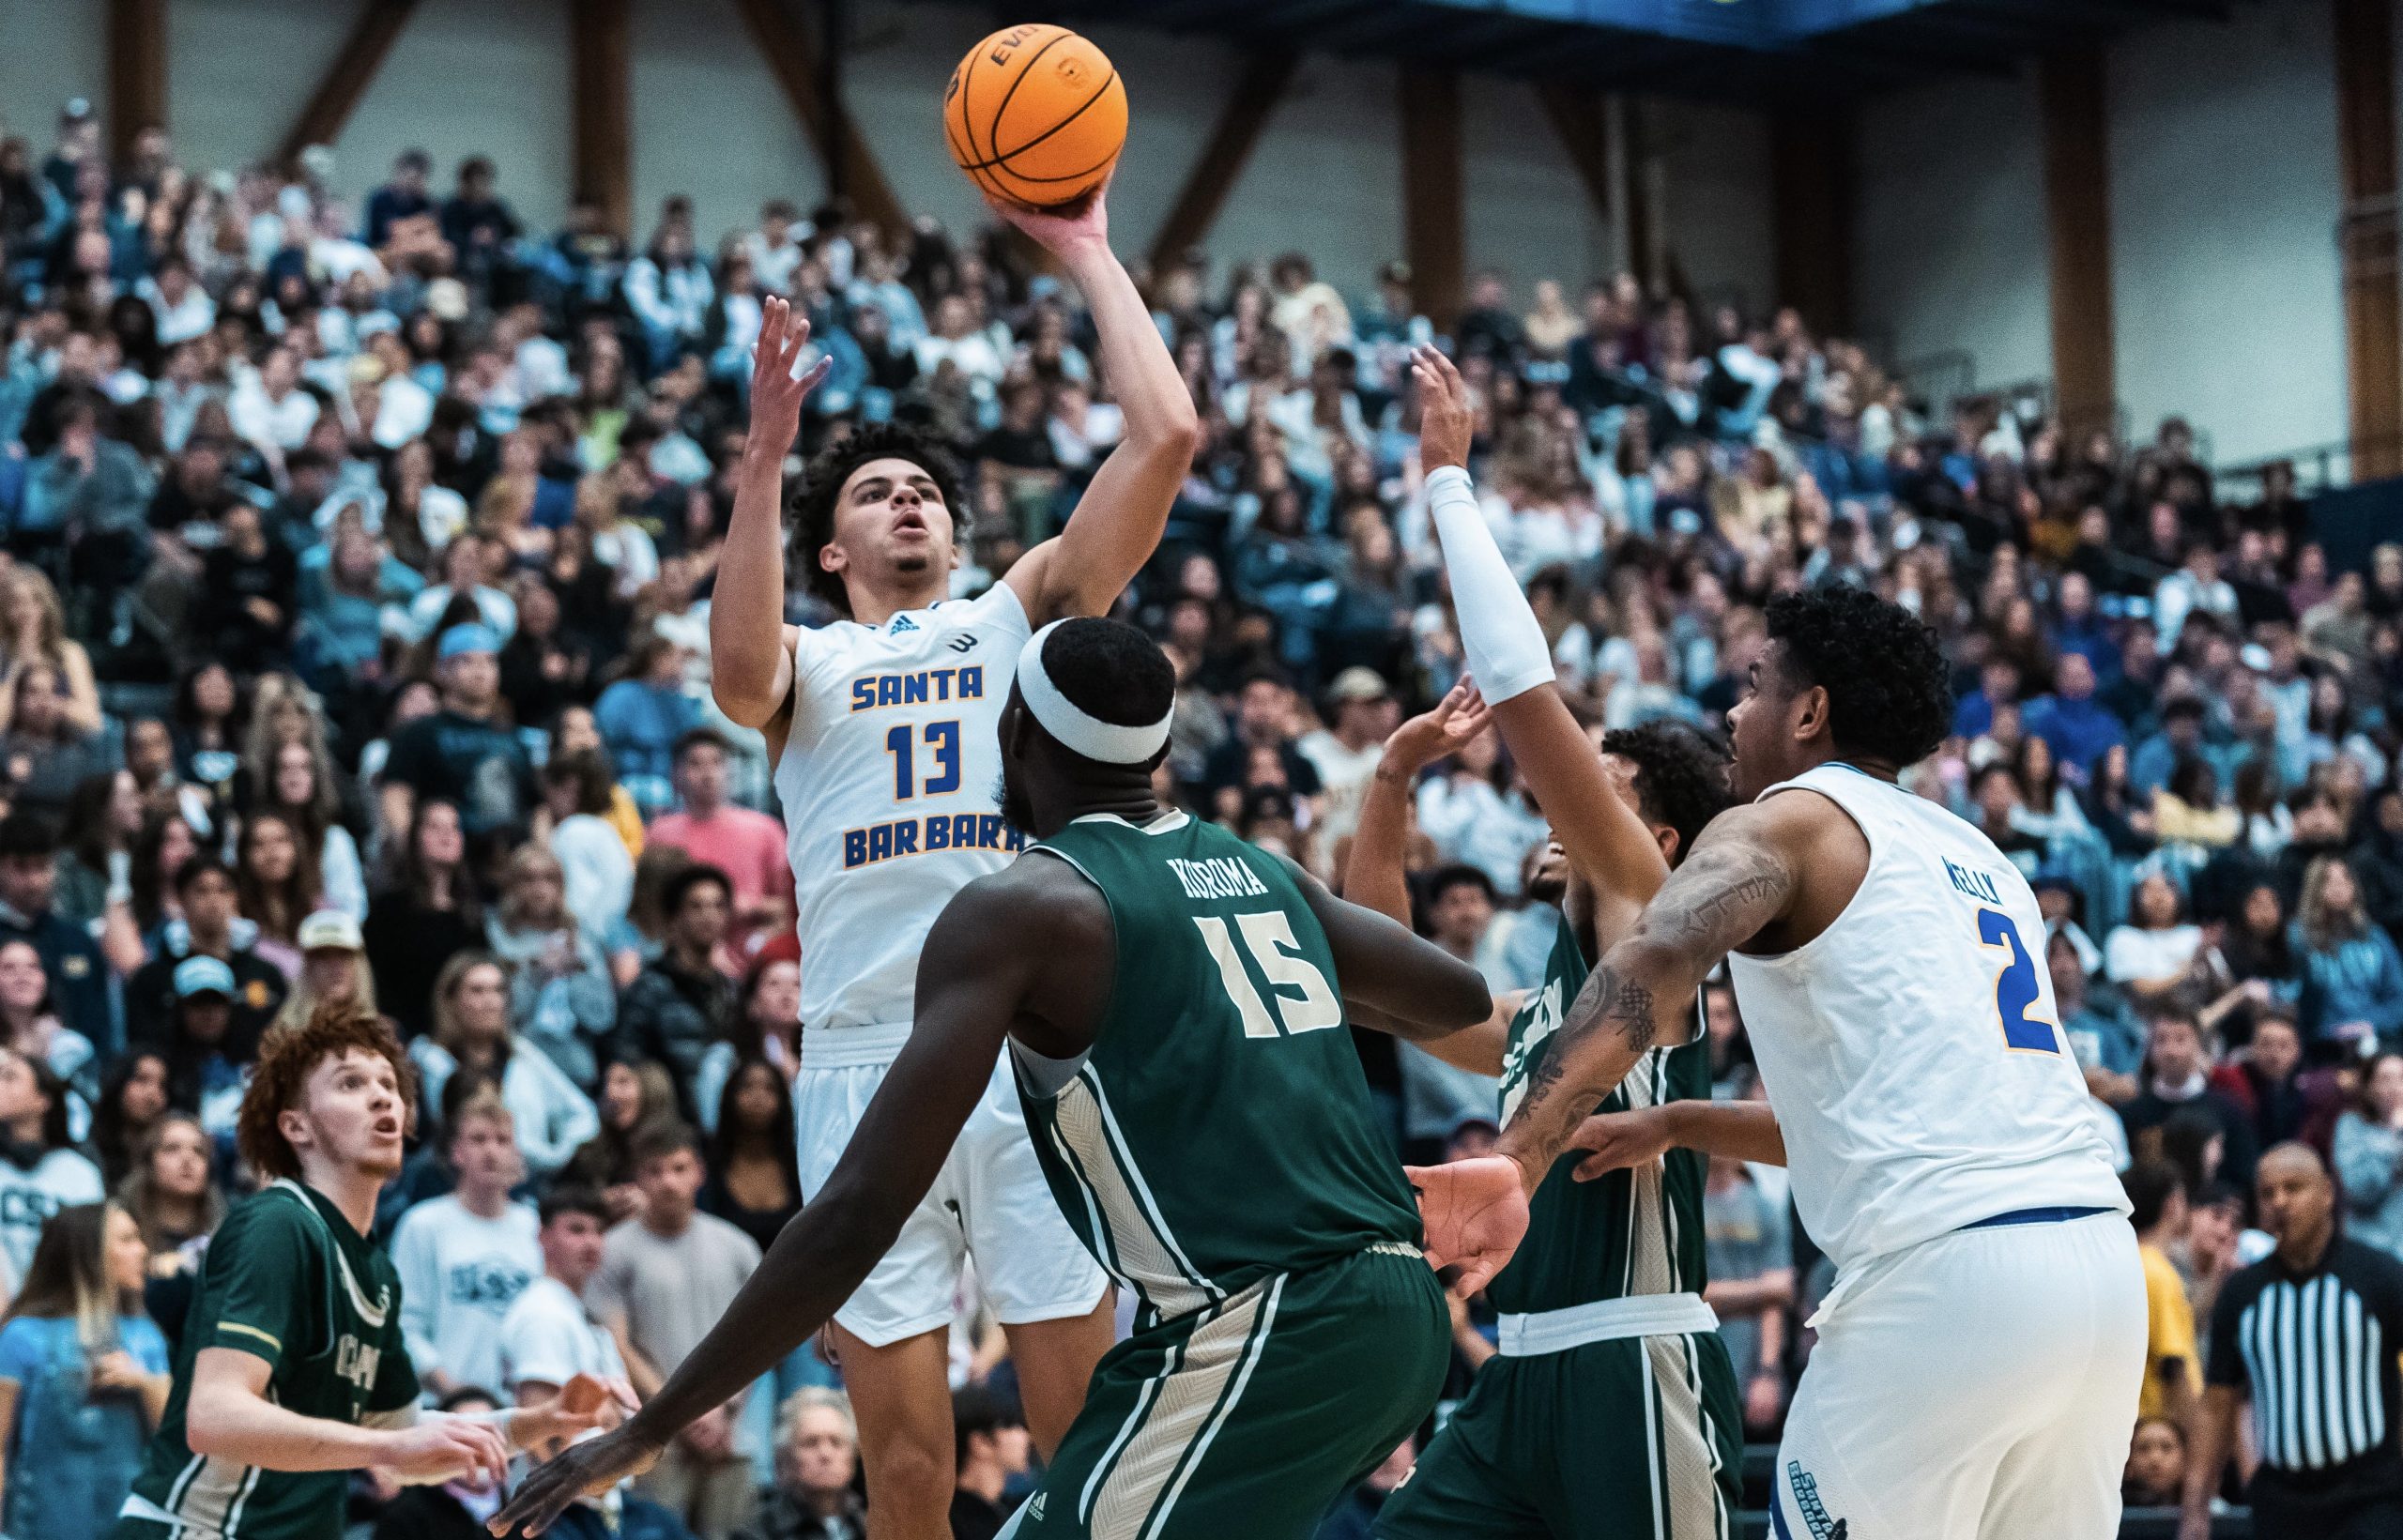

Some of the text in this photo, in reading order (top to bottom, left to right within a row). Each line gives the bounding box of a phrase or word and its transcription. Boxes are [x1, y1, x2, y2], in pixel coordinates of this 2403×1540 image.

[849, 664, 984, 713] SANTA
[885, 719, 962, 803] 13
[844, 814, 1025, 870] BARBARA
[1166, 856, 1269, 899] KOROMA
[1941, 855, 2004, 907] KELLY
[1192, 910, 1341, 1039] 15
[1975, 904, 2064, 1059] 2
